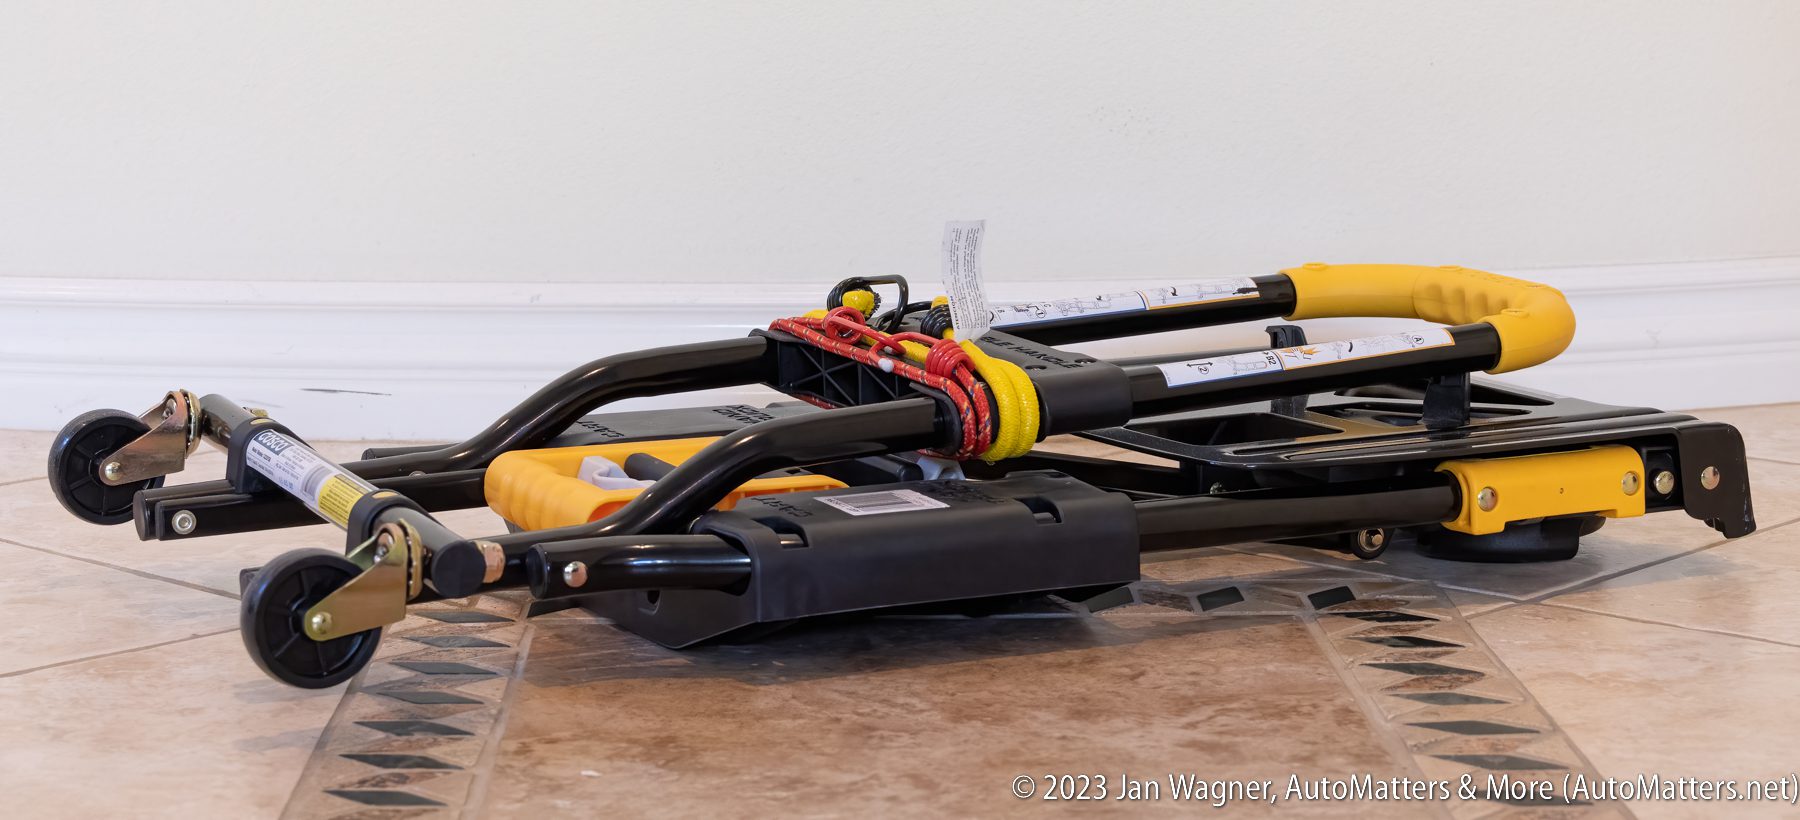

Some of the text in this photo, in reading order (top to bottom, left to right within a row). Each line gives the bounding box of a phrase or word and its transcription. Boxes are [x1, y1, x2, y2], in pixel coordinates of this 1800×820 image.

[1007, 346, 1083, 369] HANDLE
[576, 421, 625, 437] CART
[258, 431, 288, 451] COSCO
[751, 497, 813, 518] CART
